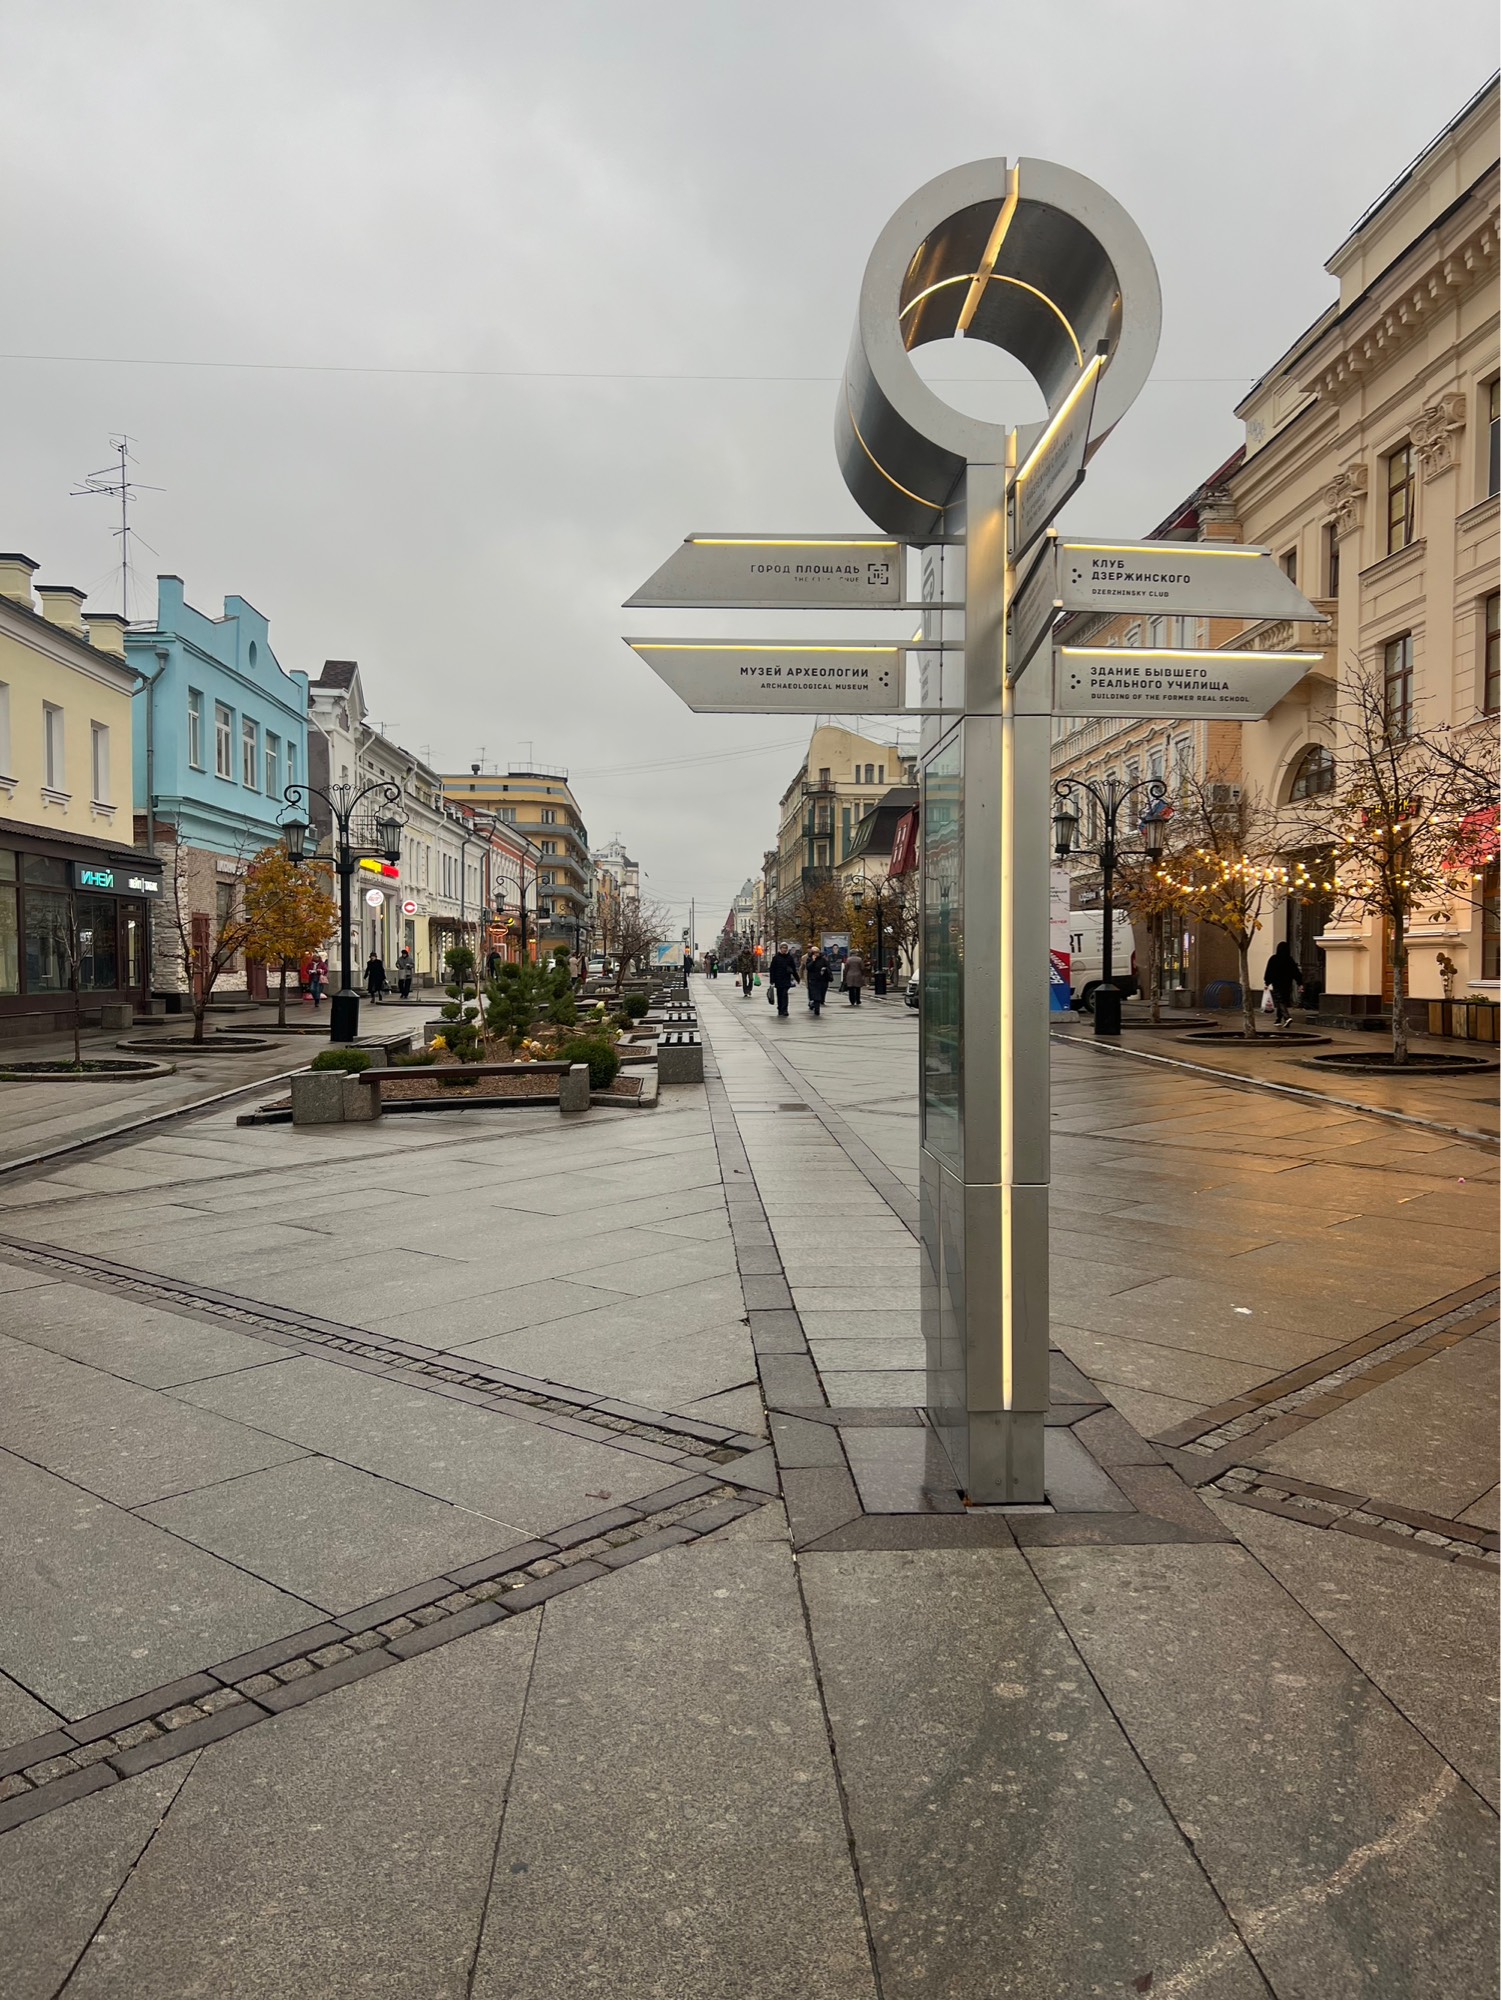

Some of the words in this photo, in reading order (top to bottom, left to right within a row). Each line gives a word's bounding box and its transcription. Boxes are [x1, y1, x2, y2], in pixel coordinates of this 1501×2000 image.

[750, 564, 790, 574] ГОРОД
[796, 566, 860, 574] ПЛОЩАДЬ
[1092, 560, 1124, 568] КЛУБ
[1092, 572, 1190, 584] ДЗЕРЖИНСКОГО
[1092, 588, 1146, 596] DZERZHINSKY
[740, 666, 782, 676] МУЗЕЙ
[786, 668, 868, 678] АРХЕОЛОГИИ
[1090, 666, 1140, 676] ЗДАНИЕ
[1144, 668, 1206, 678] БЫВШЕГО
[1090, 678, 1162, 688] РЕАЛЬНОГО
[1168, 680, 1230, 690] УЧИЛИЩА
